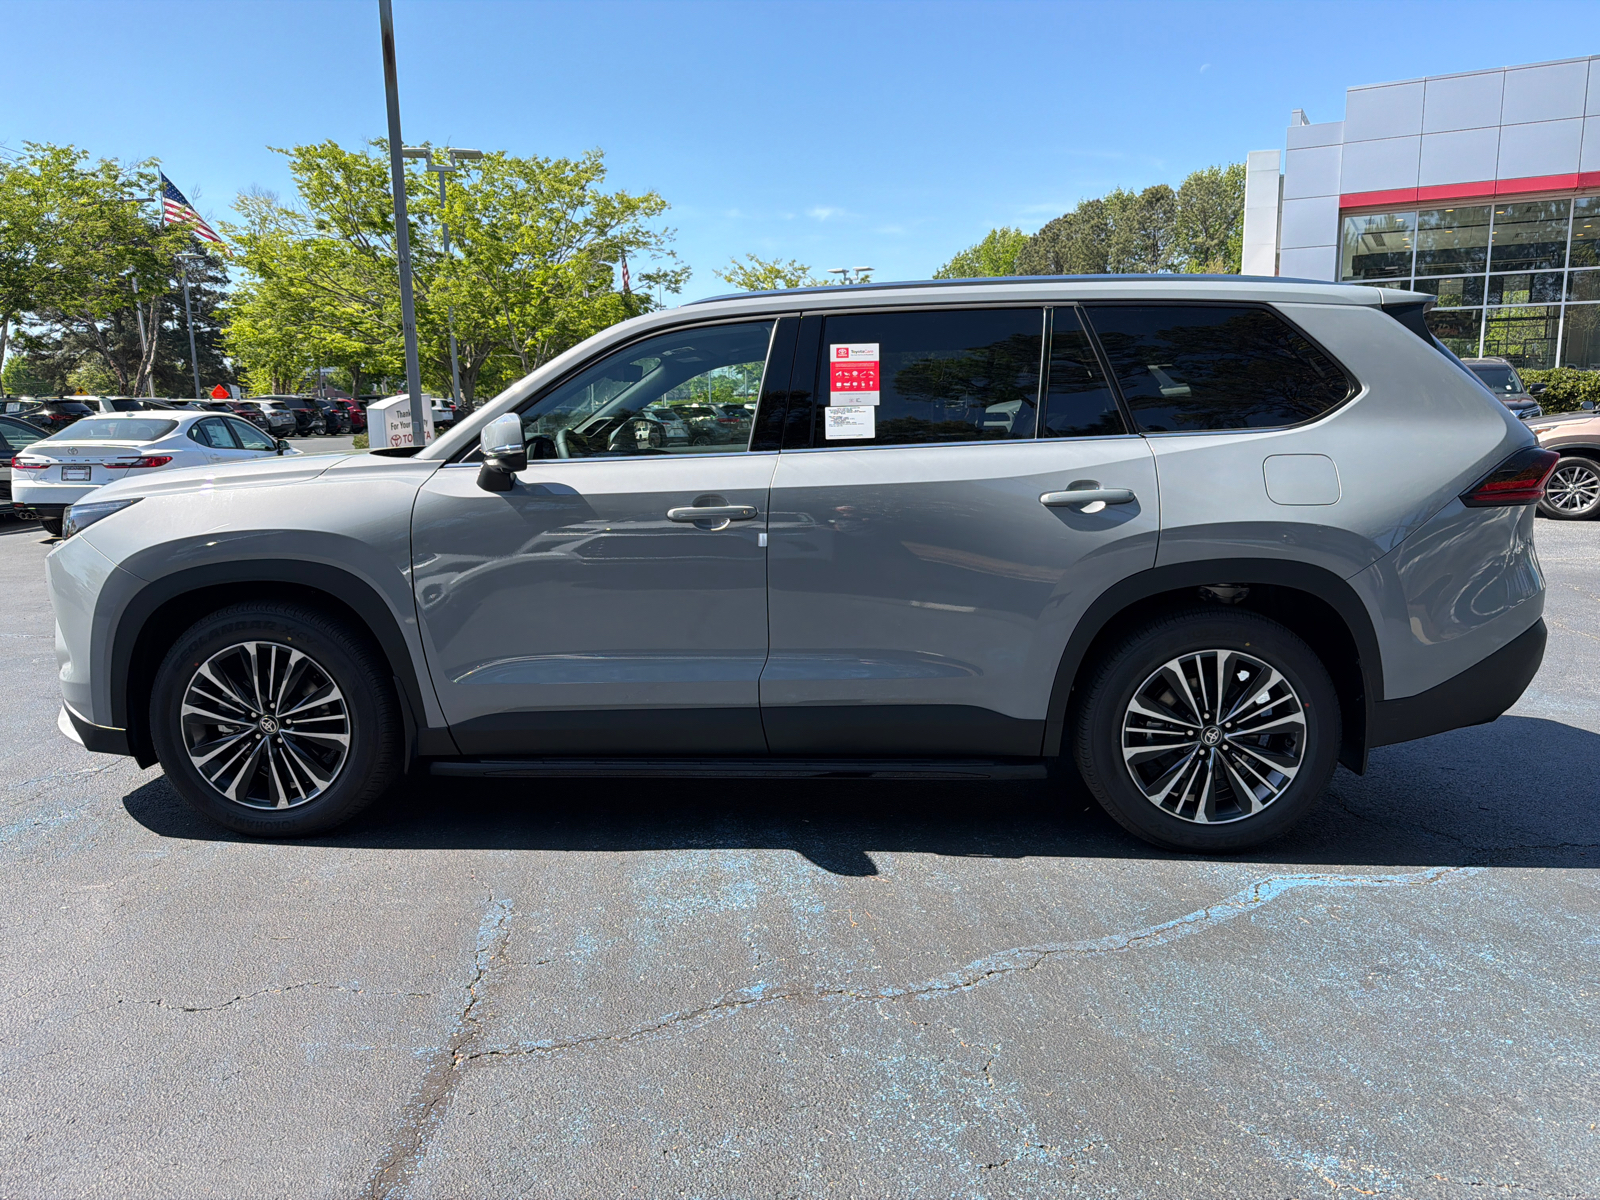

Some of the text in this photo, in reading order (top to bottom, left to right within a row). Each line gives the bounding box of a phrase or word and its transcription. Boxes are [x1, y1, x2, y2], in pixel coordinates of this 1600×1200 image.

[390, 421, 411, 431] For Your
[403, 431, 431, 443] TOA
[225, 812, 299, 831] YOKOHAMA
